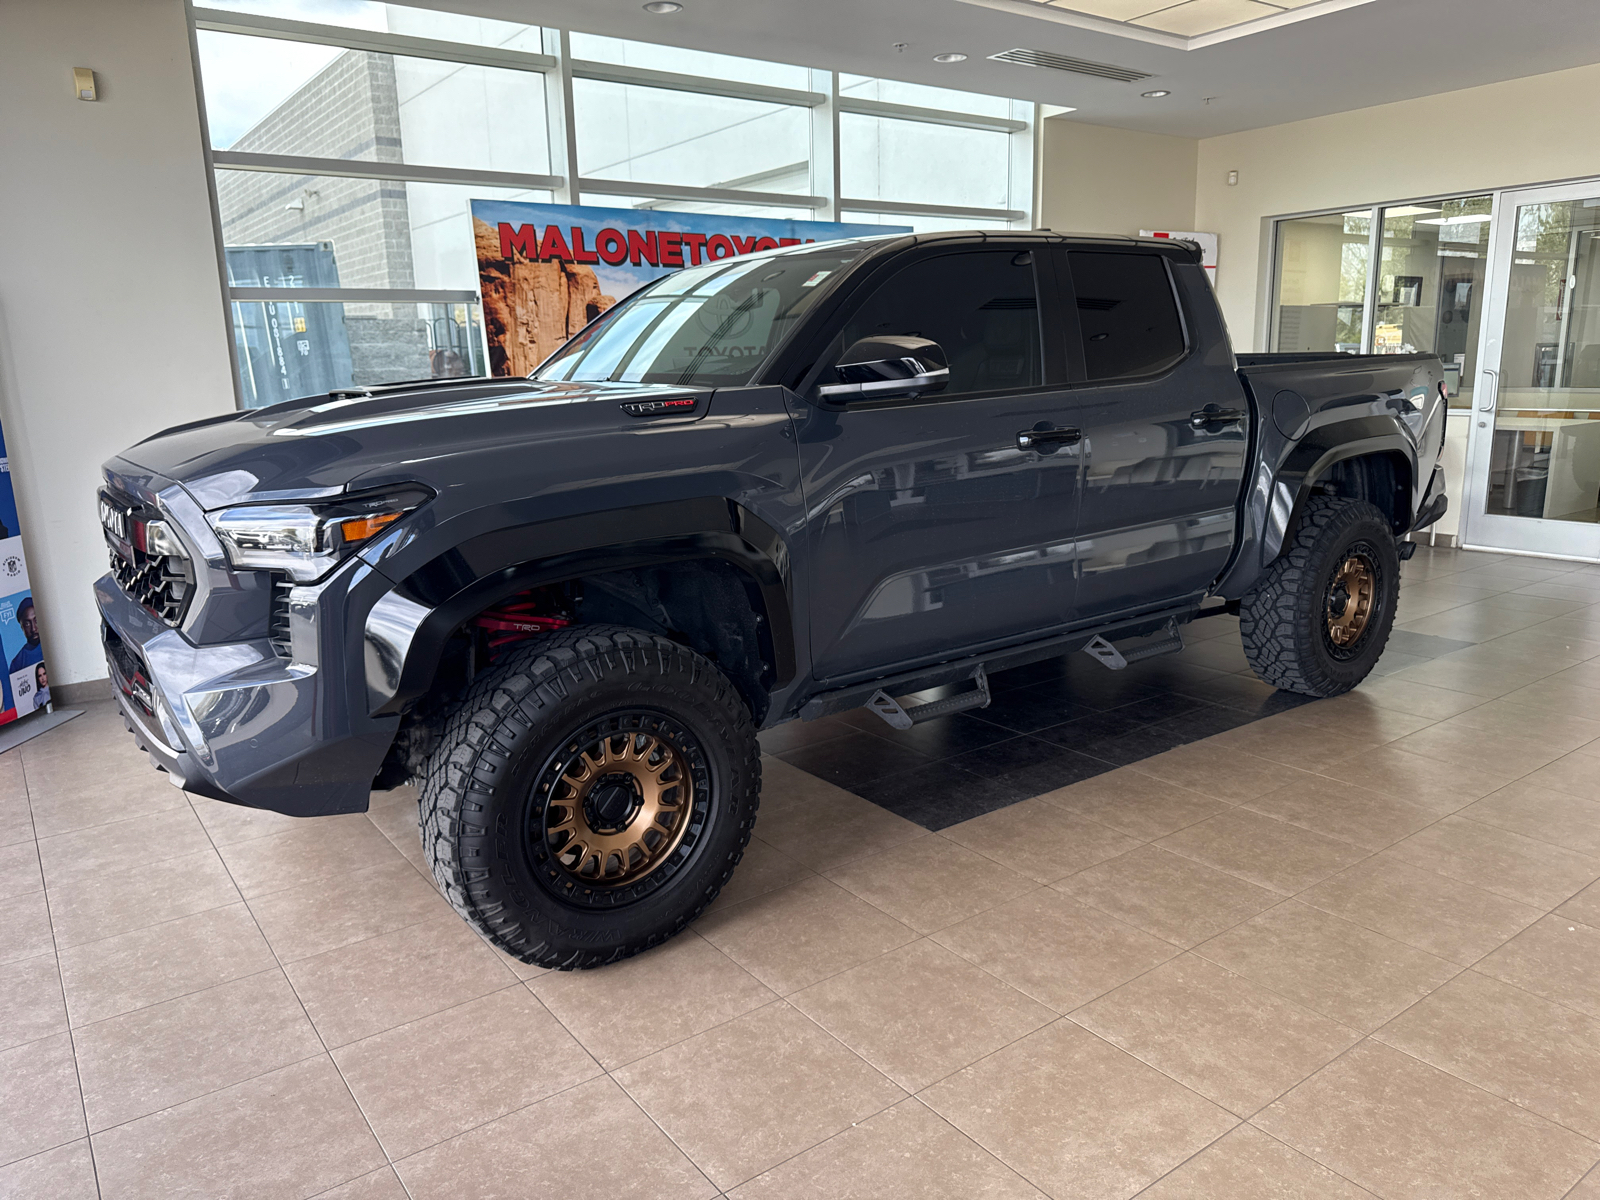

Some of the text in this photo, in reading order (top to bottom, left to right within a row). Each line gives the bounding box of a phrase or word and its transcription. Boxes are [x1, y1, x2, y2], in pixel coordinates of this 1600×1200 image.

[497, 222, 816, 268] MALONETOY
[513, 623, 541, 632] TRD
[494, 812, 622, 945] WRANGLER
